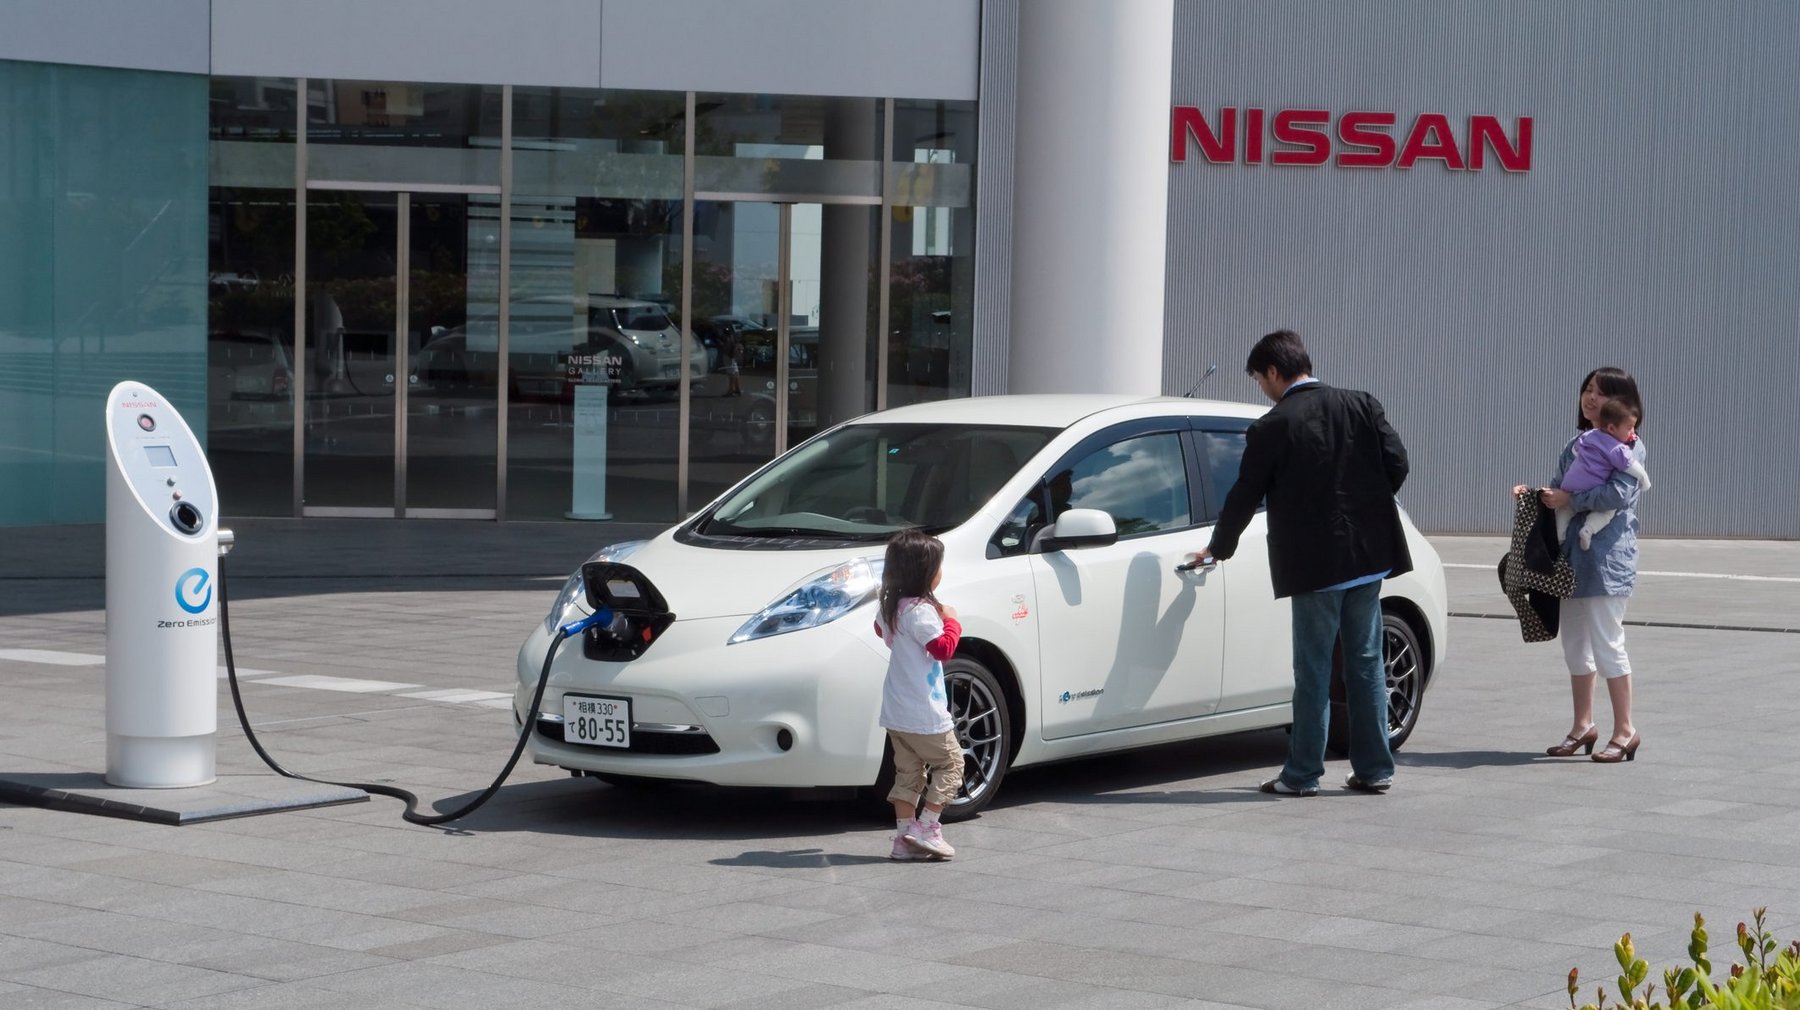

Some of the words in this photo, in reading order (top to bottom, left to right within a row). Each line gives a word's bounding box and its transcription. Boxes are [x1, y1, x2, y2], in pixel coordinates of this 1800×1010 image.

[1171, 105, 1534, 172] NISSAN
[567, 355, 623, 366] NISSAN
[567, 367, 622, 376] GALLERY
[157, 620, 185, 628] Zero
[578, 716, 626, 744] 80-55
